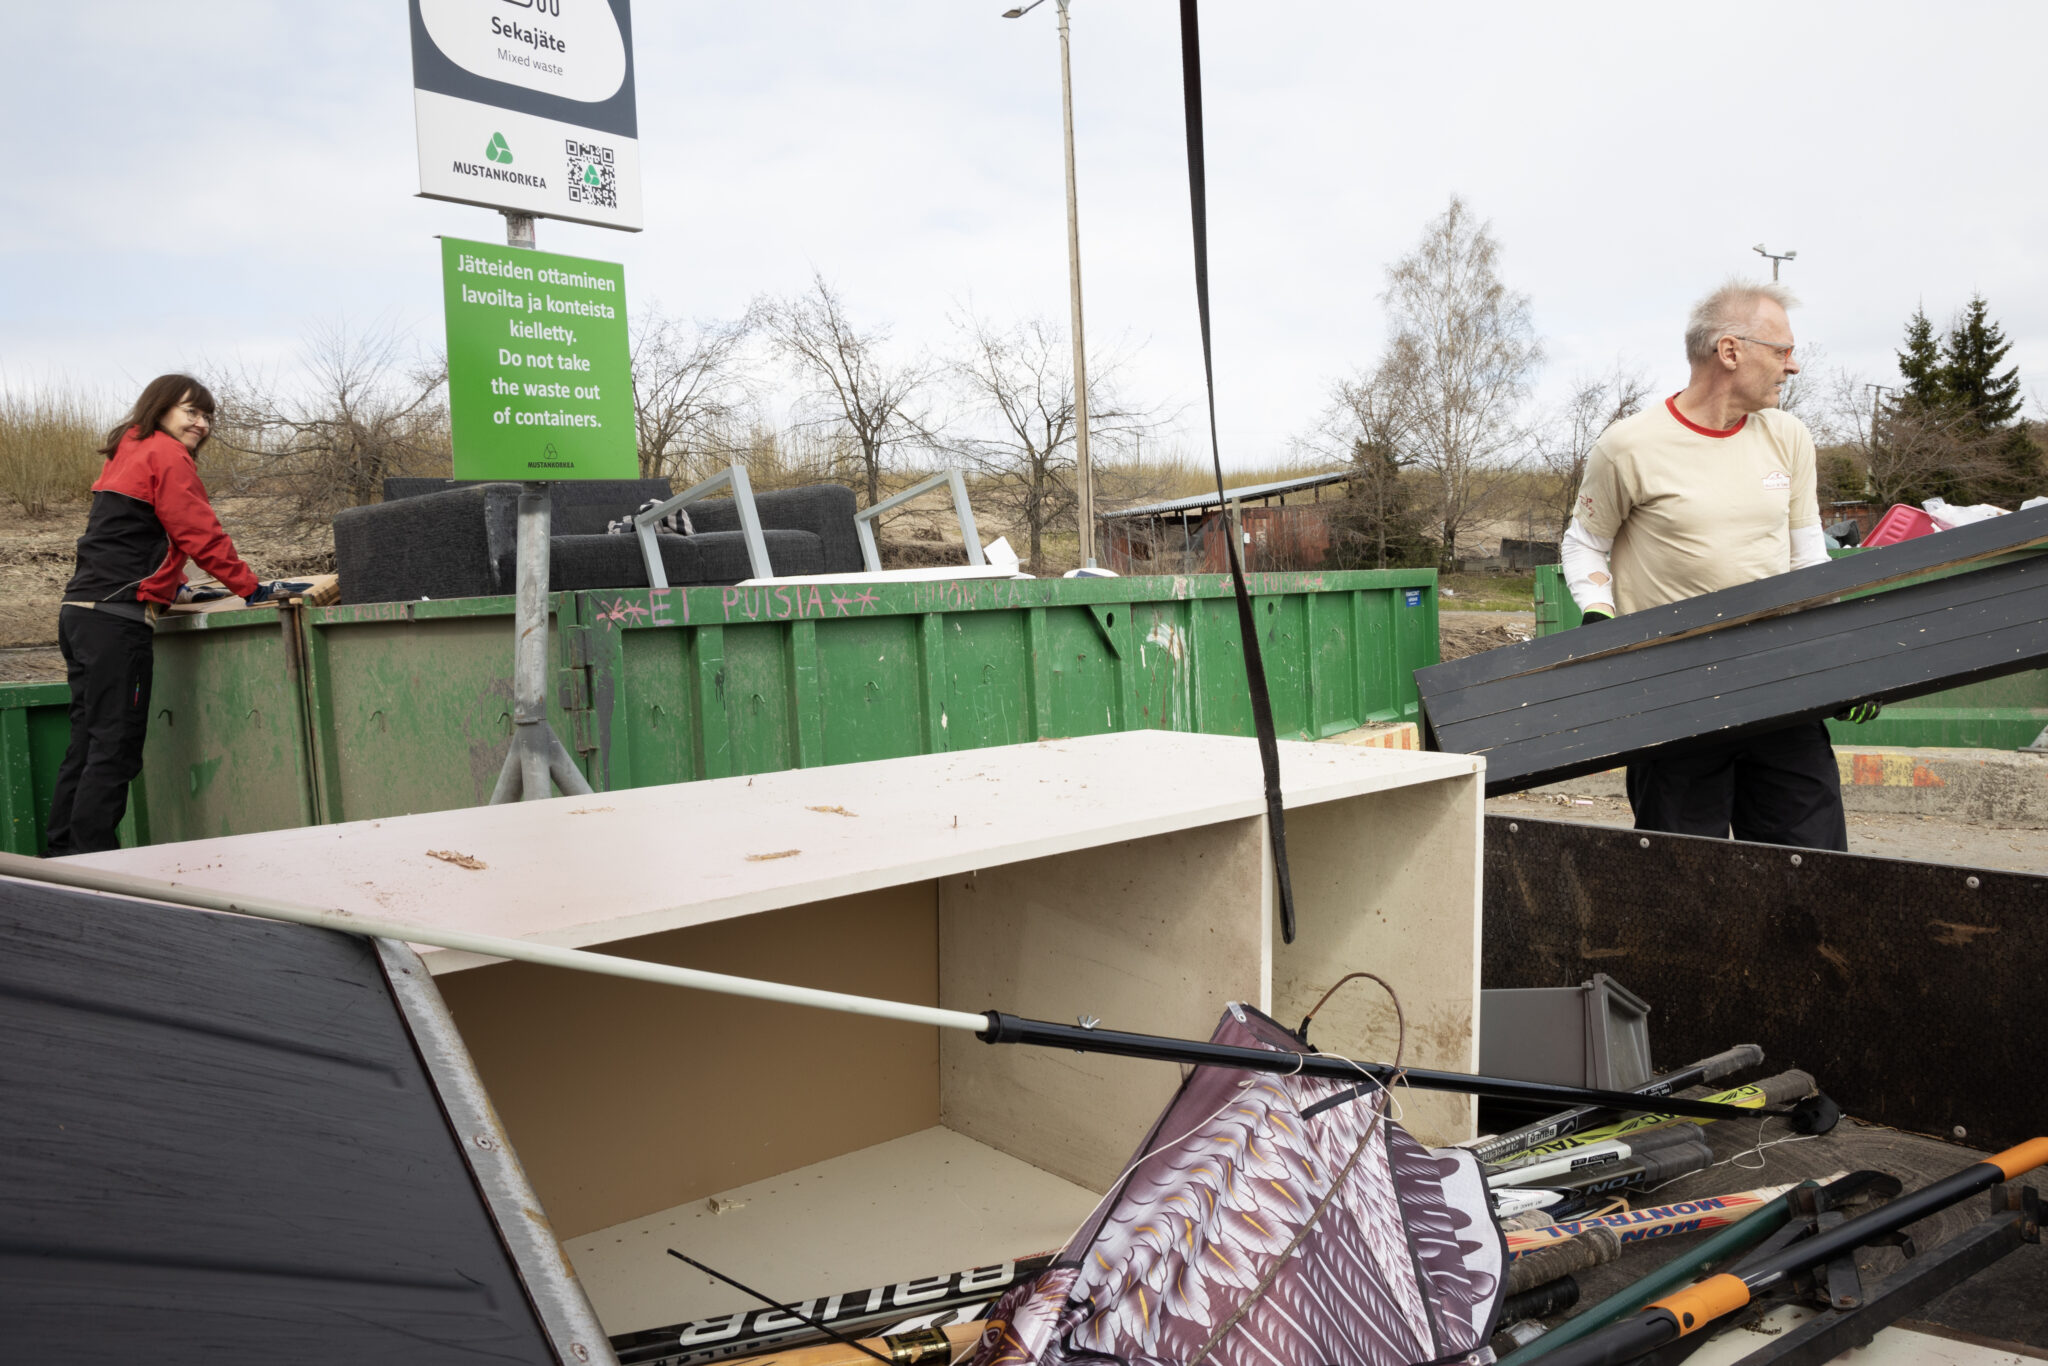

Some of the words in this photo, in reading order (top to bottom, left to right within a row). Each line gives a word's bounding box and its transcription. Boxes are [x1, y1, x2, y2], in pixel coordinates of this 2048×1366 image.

[491, 16, 566, 53] Sekajäte
[497, 48, 530, 67] Mixed
[533, 61, 564, 76] waste
[452, 161, 547, 189] MUSTANKORKEA
[457, 254, 534, 281] Jätteiden
[538, 267, 616, 292] ottaminen
[462, 284, 524, 309] lavoilta
[527, 292, 542, 314] ja
[546, 295, 615, 319] konteista
[509, 319, 577, 346] kielletty.
[499, 349, 522, 366] Do
[526, 354, 554, 369] not
[557, 353, 591, 372] take
[491, 377, 519, 395] the
[523, 382, 571, 399] waste
[574, 385, 601, 400] out
[493, 407, 511, 425] of
[515, 409, 602, 428] containers.
[527, 461, 575, 469] MUSTANKORKEA
[1535, 1197, 1728, 1238] MONTREAL
